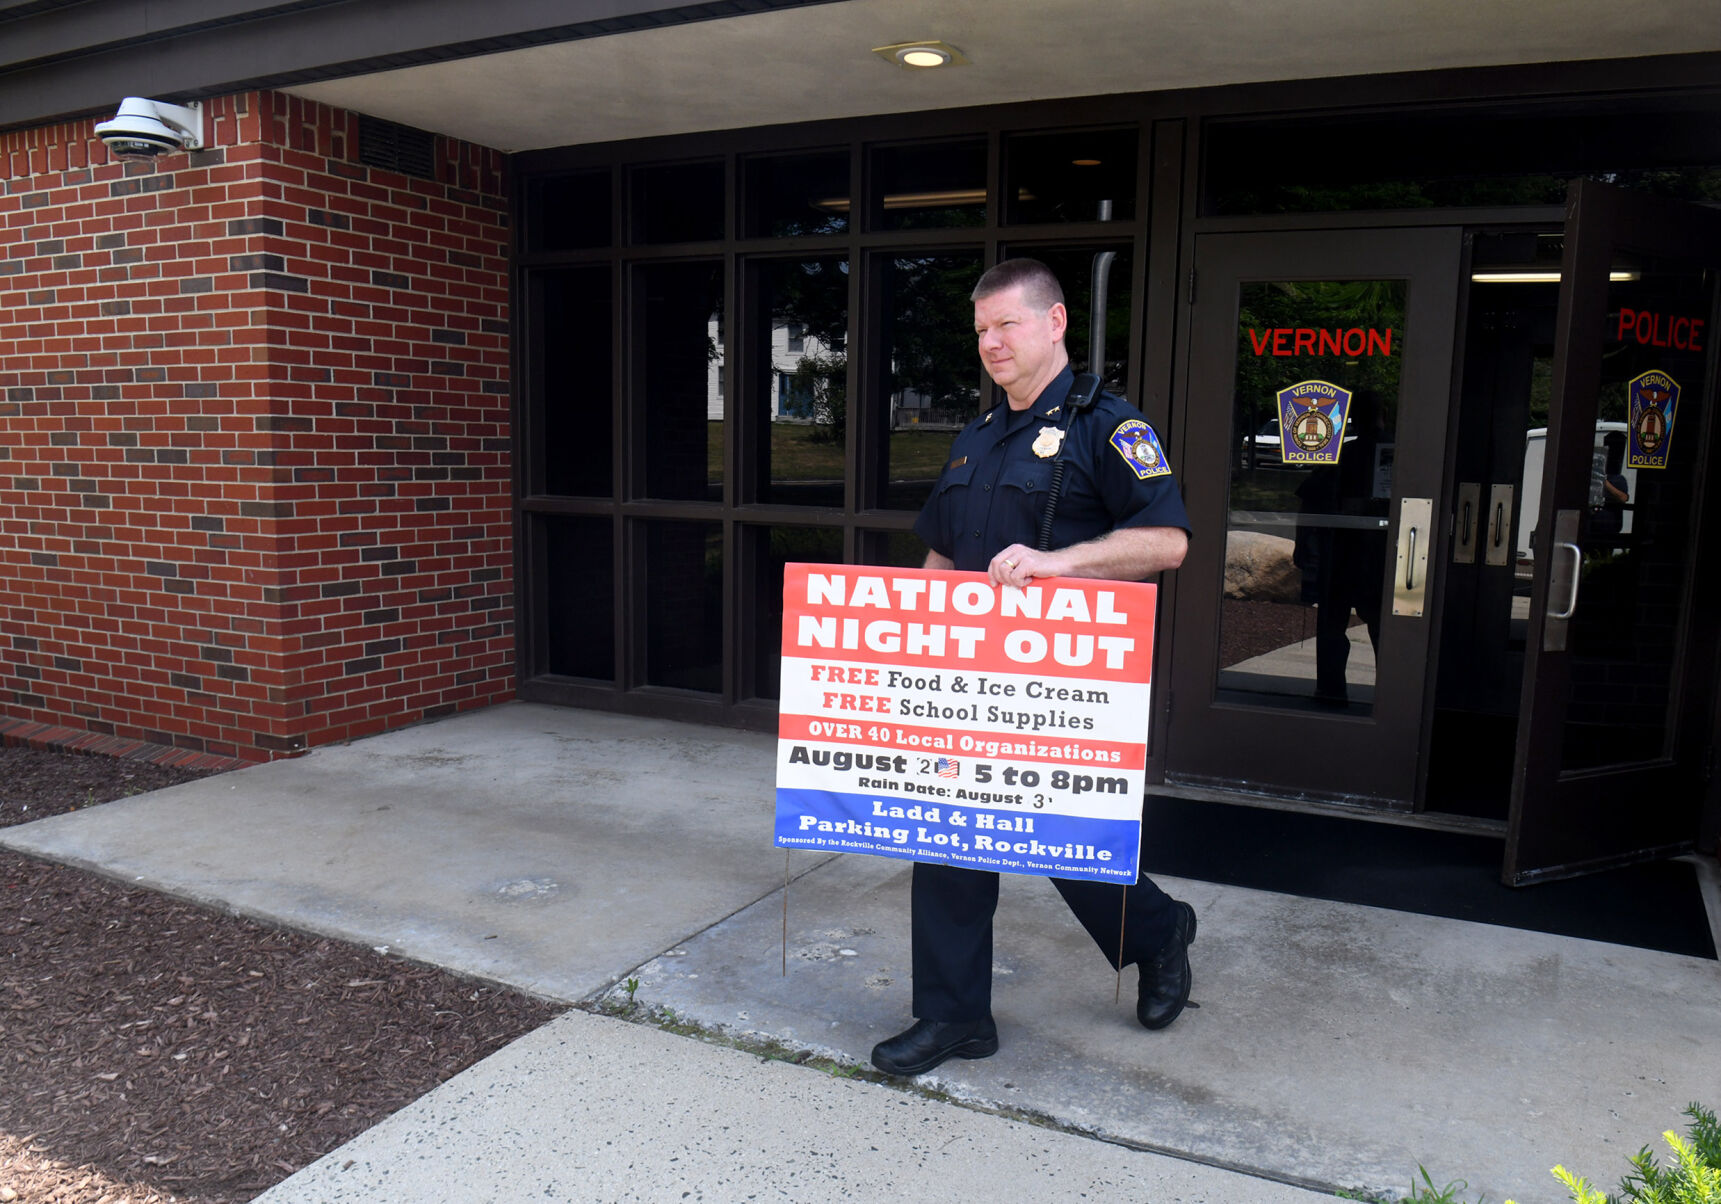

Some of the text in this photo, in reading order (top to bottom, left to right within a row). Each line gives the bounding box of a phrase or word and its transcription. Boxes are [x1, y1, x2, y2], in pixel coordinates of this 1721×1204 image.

[1249, 328, 1392, 356] VERNON
[1617, 308, 1704, 351] POLICE
[1292, 384, 1337, 398] VERNON
[1640, 375, 1672, 391] VERNON
[1118, 421, 1147, 435] VERNON
[1140, 466, 1168, 476] POLICE
[1288, 452, 1333, 461] POLICE
[1632, 455, 1663, 465] POLICE
[807, 573, 1128, 625] NATIONAL
[797, 615, 1135, 670] NIGHT OUT
[811, 664, 1110, 704] FREE Food & Ice Cream
[822, 692, 1095, 731] FREE School Supplies
[809, 721, 1121, 763] OVER 40 Local Organizations
[789, 746, 908, 774] August
[975, 764, 993, 783] 5
[1002, 767, 1040, 787] to
[1051, 770, 1128, 795] 8pm
[858, 777, 899, 791] Rain
[904, 782, 951, 797] Date:
[956, 789, 1023, 804] August
[872, 801, 1034, 833] Ladd & Hall
[799, 815, 1112, 861] Parking Lot, Rockville
[778, 836, 816, 844] Sponsored
[817, 838, 827, 846] By
[841, 840, 874, 849] Rockville
[876, 844, 916, 856] Community
[951, 852, 976, 862] Vernon
[978, 856, 1001, 865] Police
[1027, 861, 1053, 870] Vernon
[1055, 864, 1099, 875] Community
[1100, 867, 1133, 877] Network
